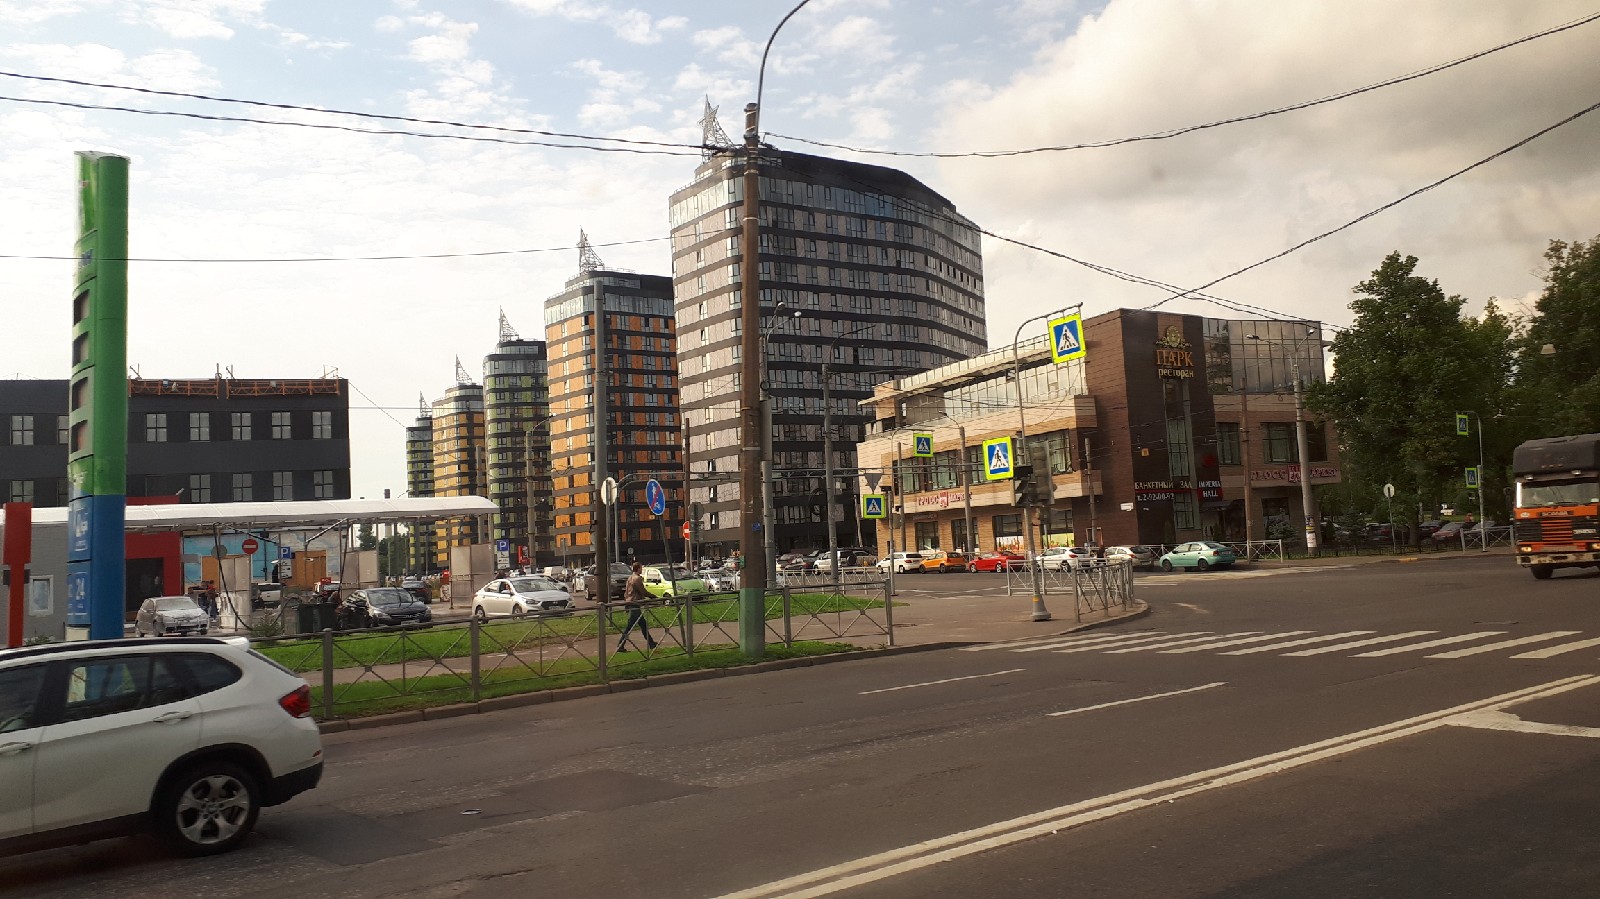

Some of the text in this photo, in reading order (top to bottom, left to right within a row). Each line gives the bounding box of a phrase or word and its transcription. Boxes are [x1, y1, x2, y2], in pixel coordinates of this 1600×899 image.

[1156, 350, 1194, 367] ПАРК
[1158, 368, 1194, 380] ресторан
[1134, 480, 1193, 490] БАНКЕТНЫЙ ЗАЛ
[1202, 490, 1218, 498] HALL
